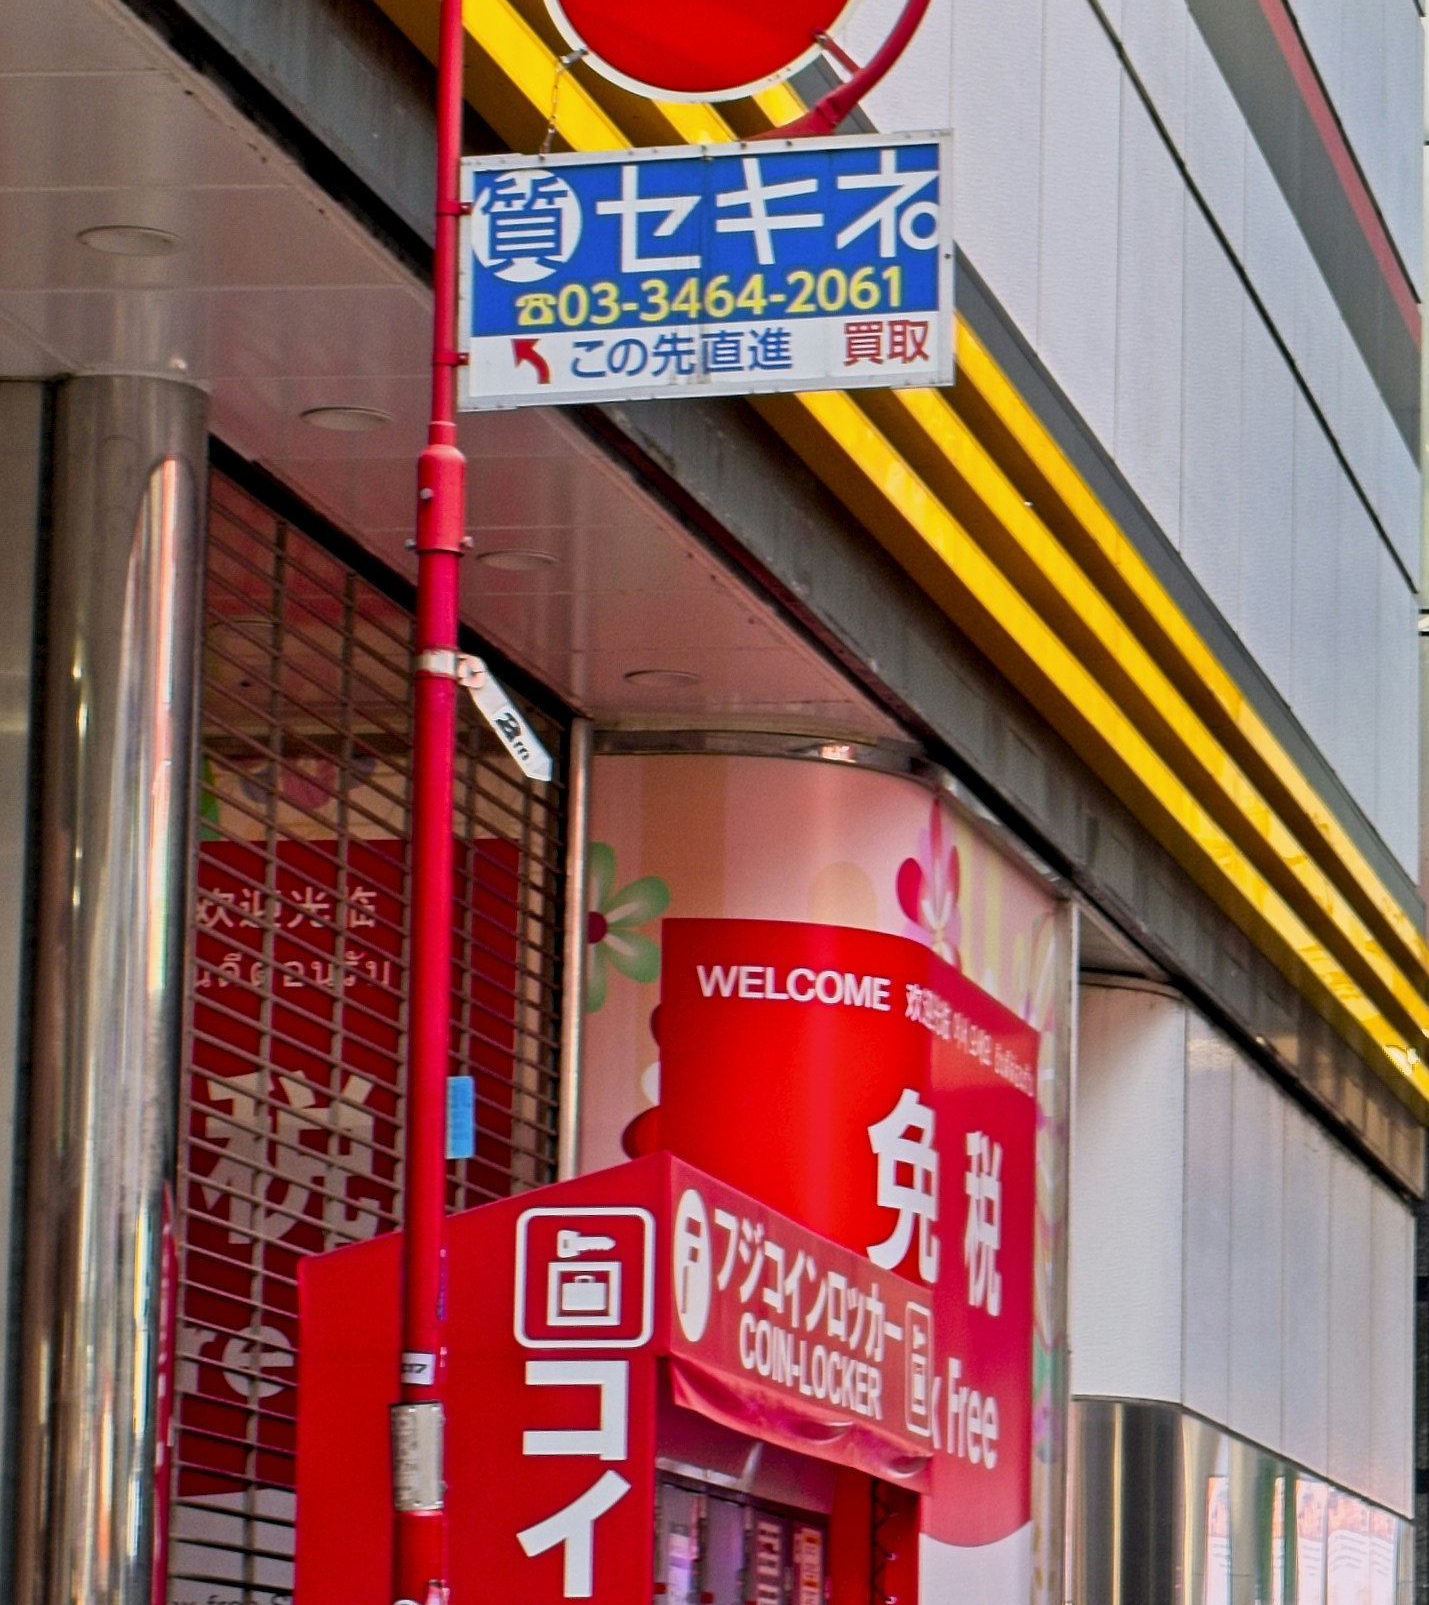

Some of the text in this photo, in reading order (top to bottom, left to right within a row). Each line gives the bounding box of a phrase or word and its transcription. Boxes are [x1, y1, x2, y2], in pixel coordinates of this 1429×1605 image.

[557, 266, 903, 327] 03-3464-2061
[569, 319, 930, 379] この先直進 買取
[697, 965, 891, 1012] WELCOME
[867, 1087, 1003, 1319] 免税
[739, 1312, 884, 1421] COIN-LOCKER
[947, 1357, 999, 1470] Free
